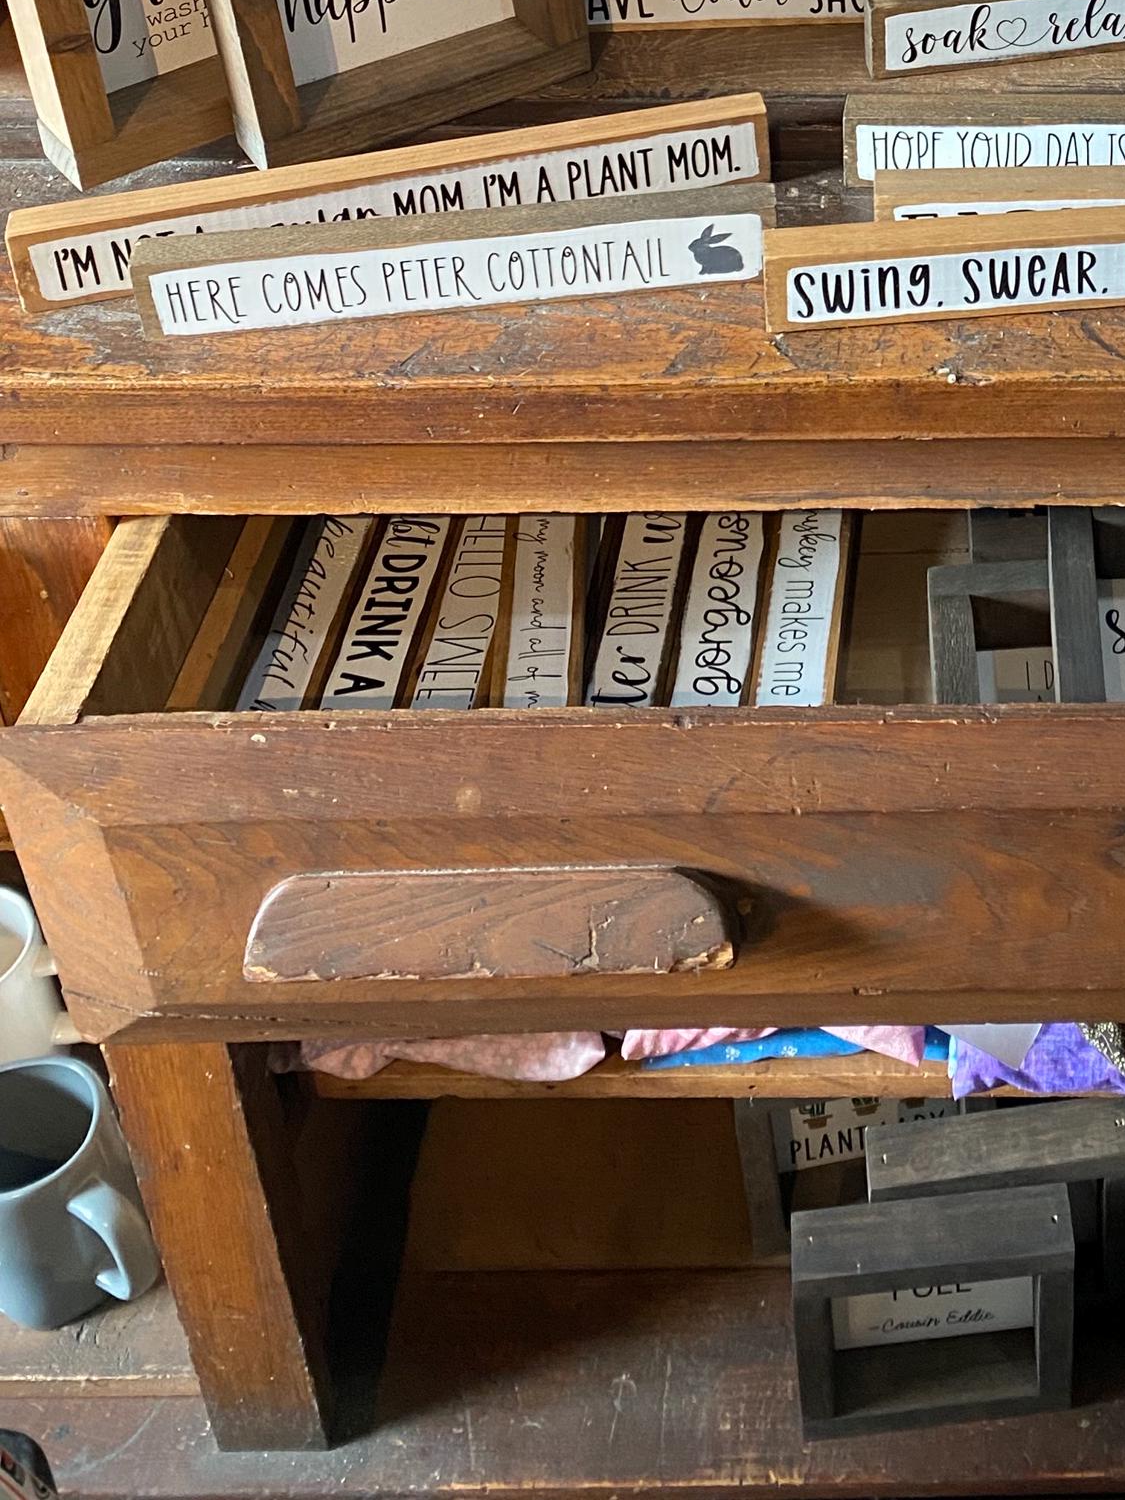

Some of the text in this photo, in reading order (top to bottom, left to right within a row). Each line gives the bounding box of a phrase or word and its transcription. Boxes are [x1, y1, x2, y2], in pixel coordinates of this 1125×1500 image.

[132, 21, 191, 57] your
[902, 5, 989, 62] soak
[870, 131, 945, 170] HOPE
[1047, 132, 1095, 166] DAY
[54, 246, 100, 291] I'M
[394, 177, 464, 214] MOM
[483, 173, 520, 208] I'M
[538, 166, 554, 203] A
[567, 147, 652, 198] PLANT
[669, 133, 741, 181] MOM.
[164, 236, 671, 323] HERE COMES PETER COTTONTAIL
[513, 518, 549, 545] my
[530, 552, 551, 596] moon
[606, 556, 673, 637] DRINK
[263, 517, 352, 689] beautiful
[333, 553, 421, 696] DRINK A
[520, 598, 567, 631] and
[415, 614, 494, 710] SWEE
[518, 637, 565, 660] all
[771, 580, 823, 697] makes me
[789, 1126, 866, 1164] PLANT
